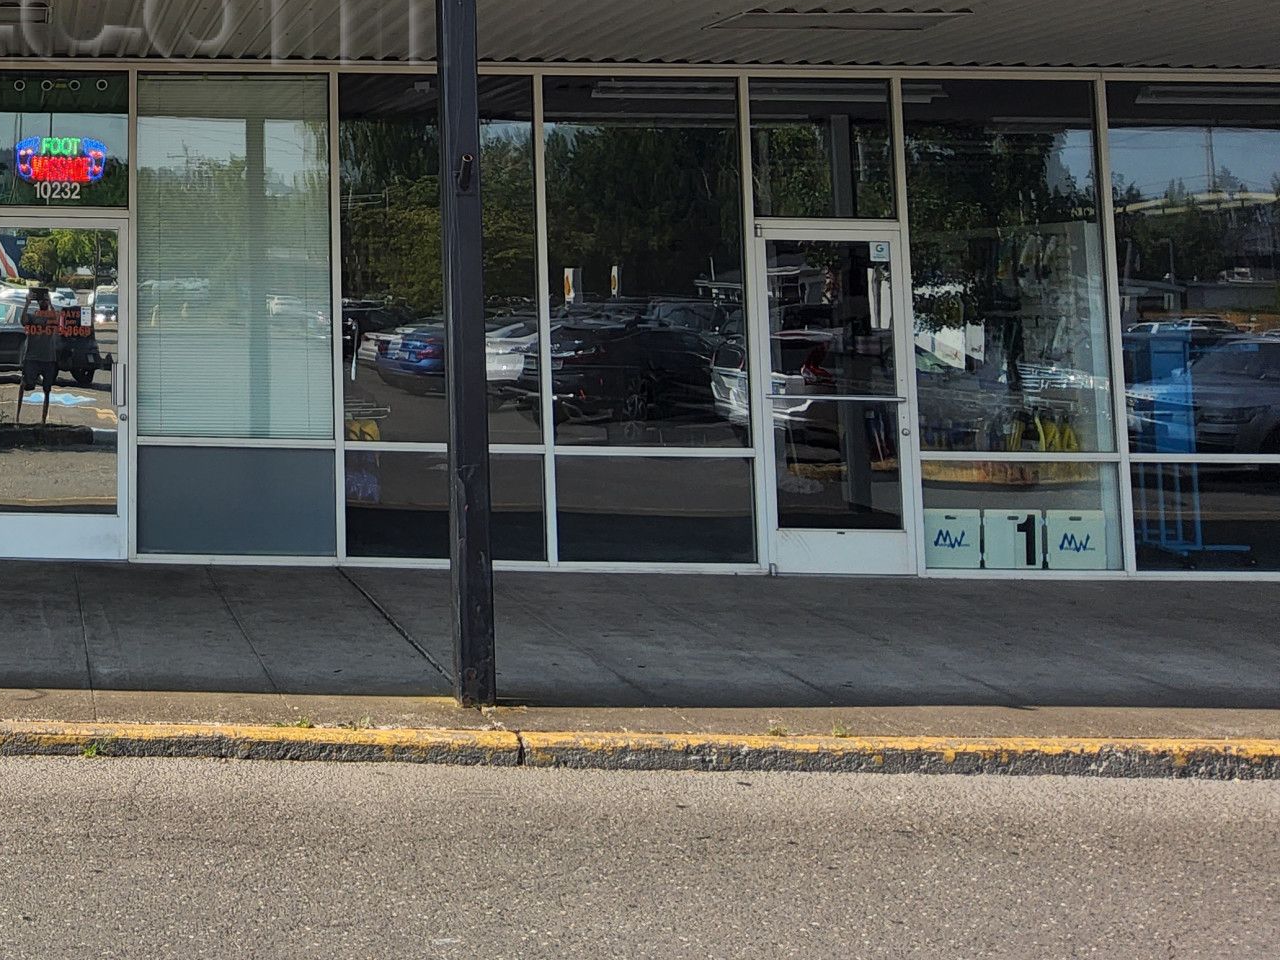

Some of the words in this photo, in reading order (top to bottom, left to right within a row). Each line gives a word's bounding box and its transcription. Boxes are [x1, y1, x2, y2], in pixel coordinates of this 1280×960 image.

[40, 137, 81, 156] FOOT
[31, 155, 91, 182] MASSAGE
[33, 181, 81, 199] 10232
[1016, 514, 1036, 566] 1
